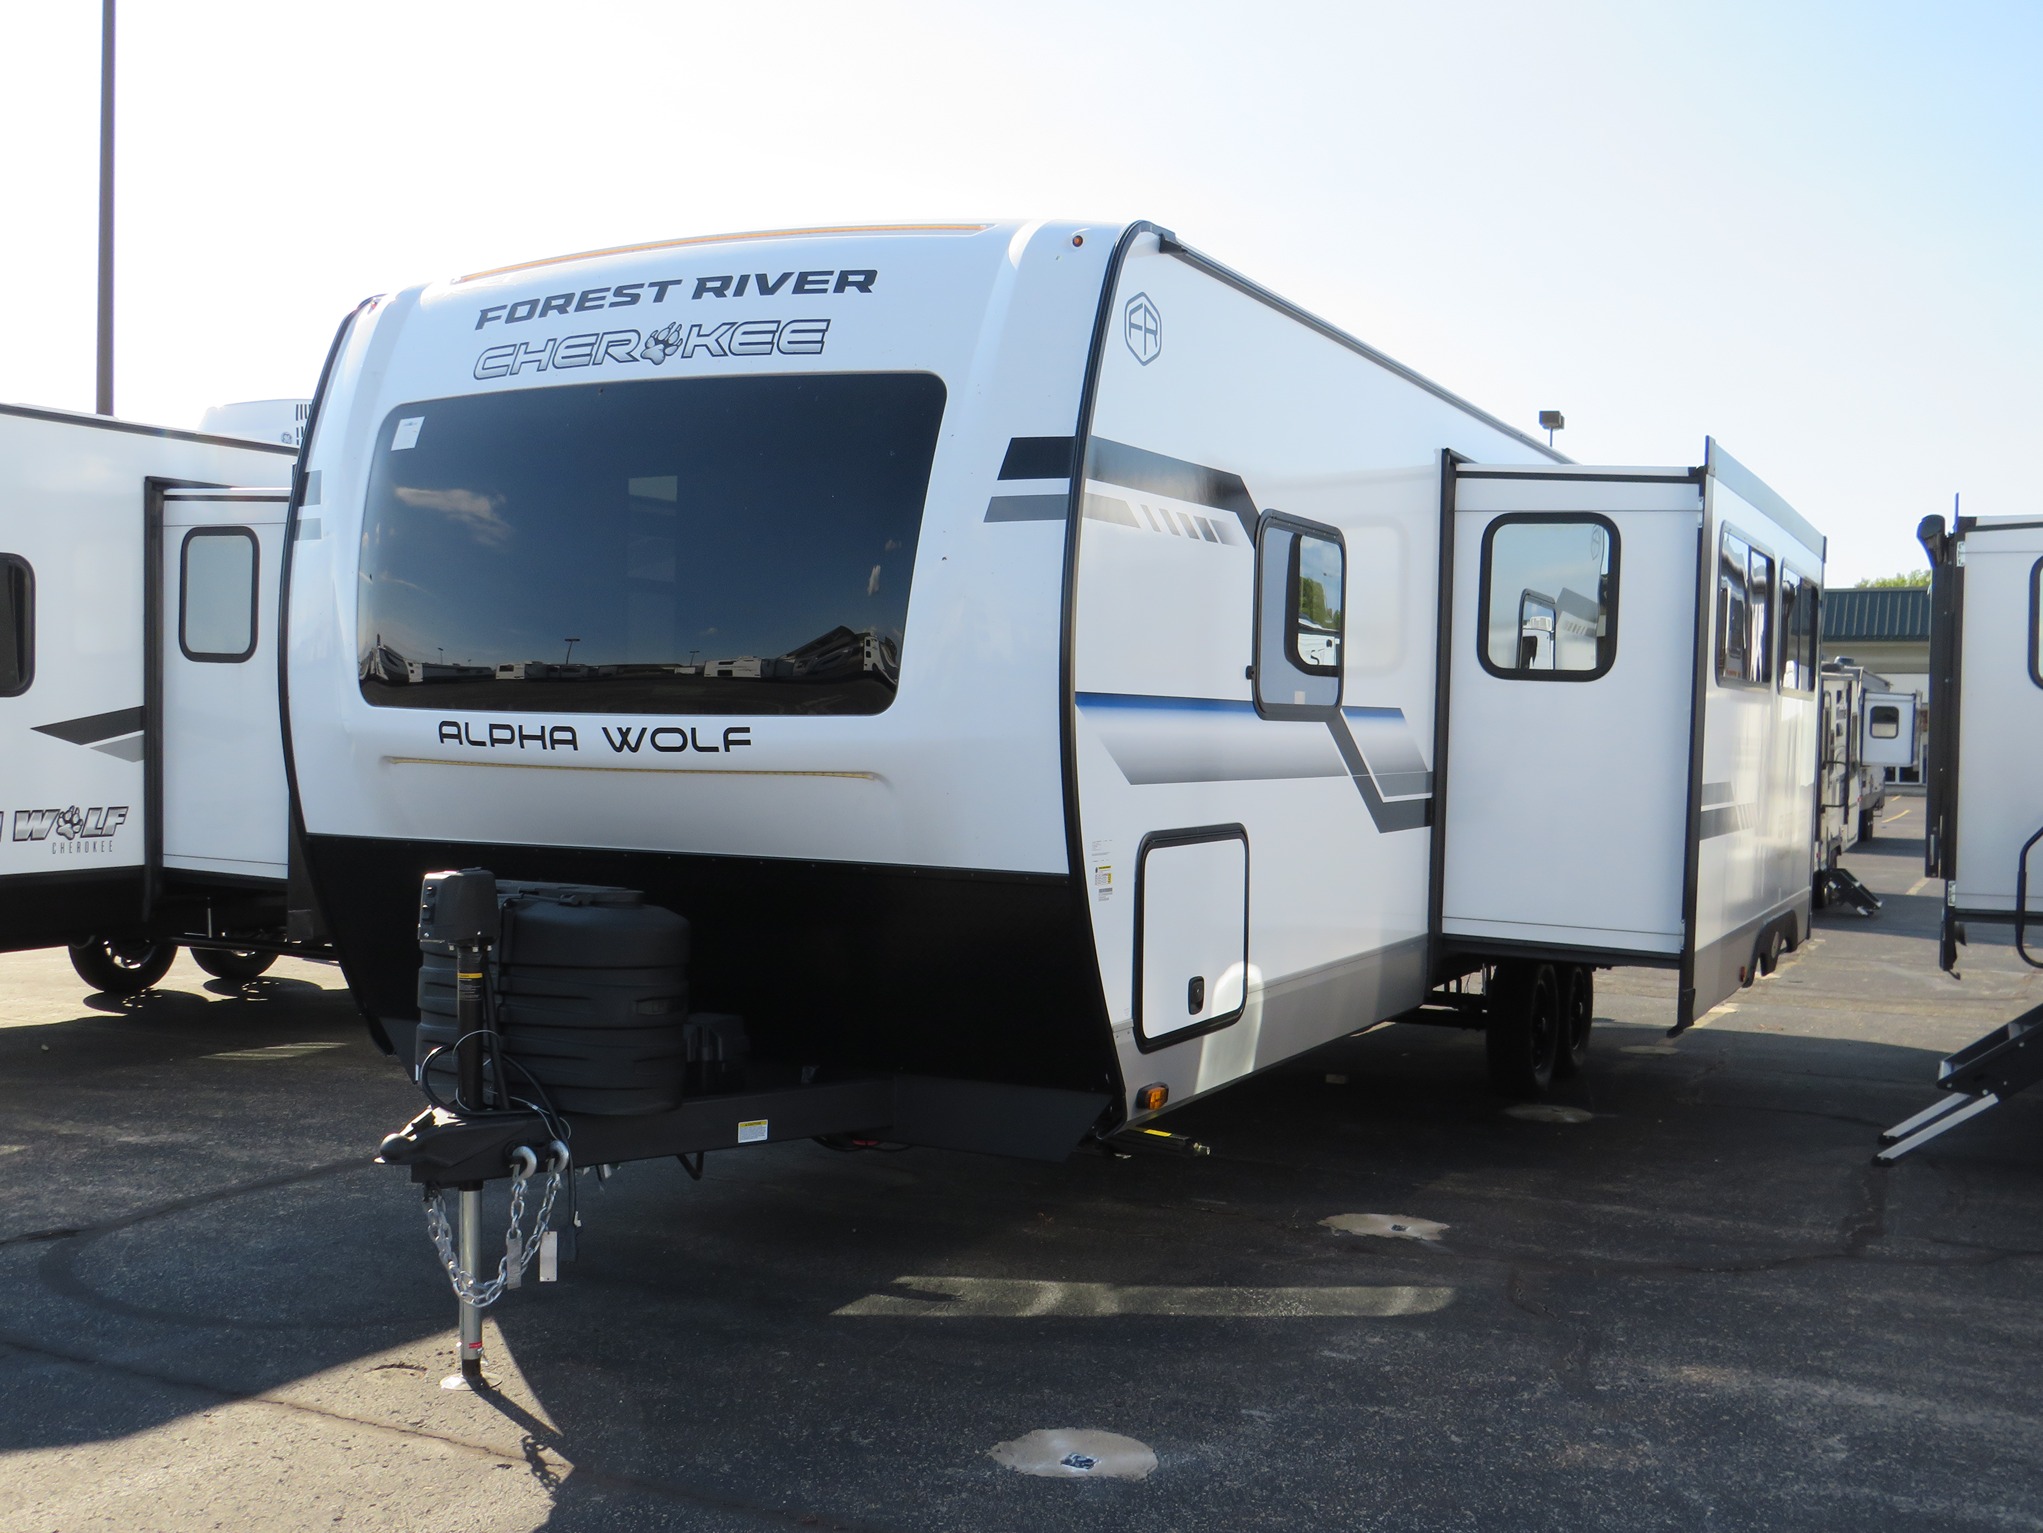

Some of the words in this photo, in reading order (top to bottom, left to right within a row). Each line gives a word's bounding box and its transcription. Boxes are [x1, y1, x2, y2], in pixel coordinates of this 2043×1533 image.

[474, 279, 682, 331] FOREST
[691, 269, 878, 300] RIVER
[438, 720, 578, 751] ALPHA
[601, 727, 751, 753] WOLF
[52, 840, 113, 854] CHEROKEE
